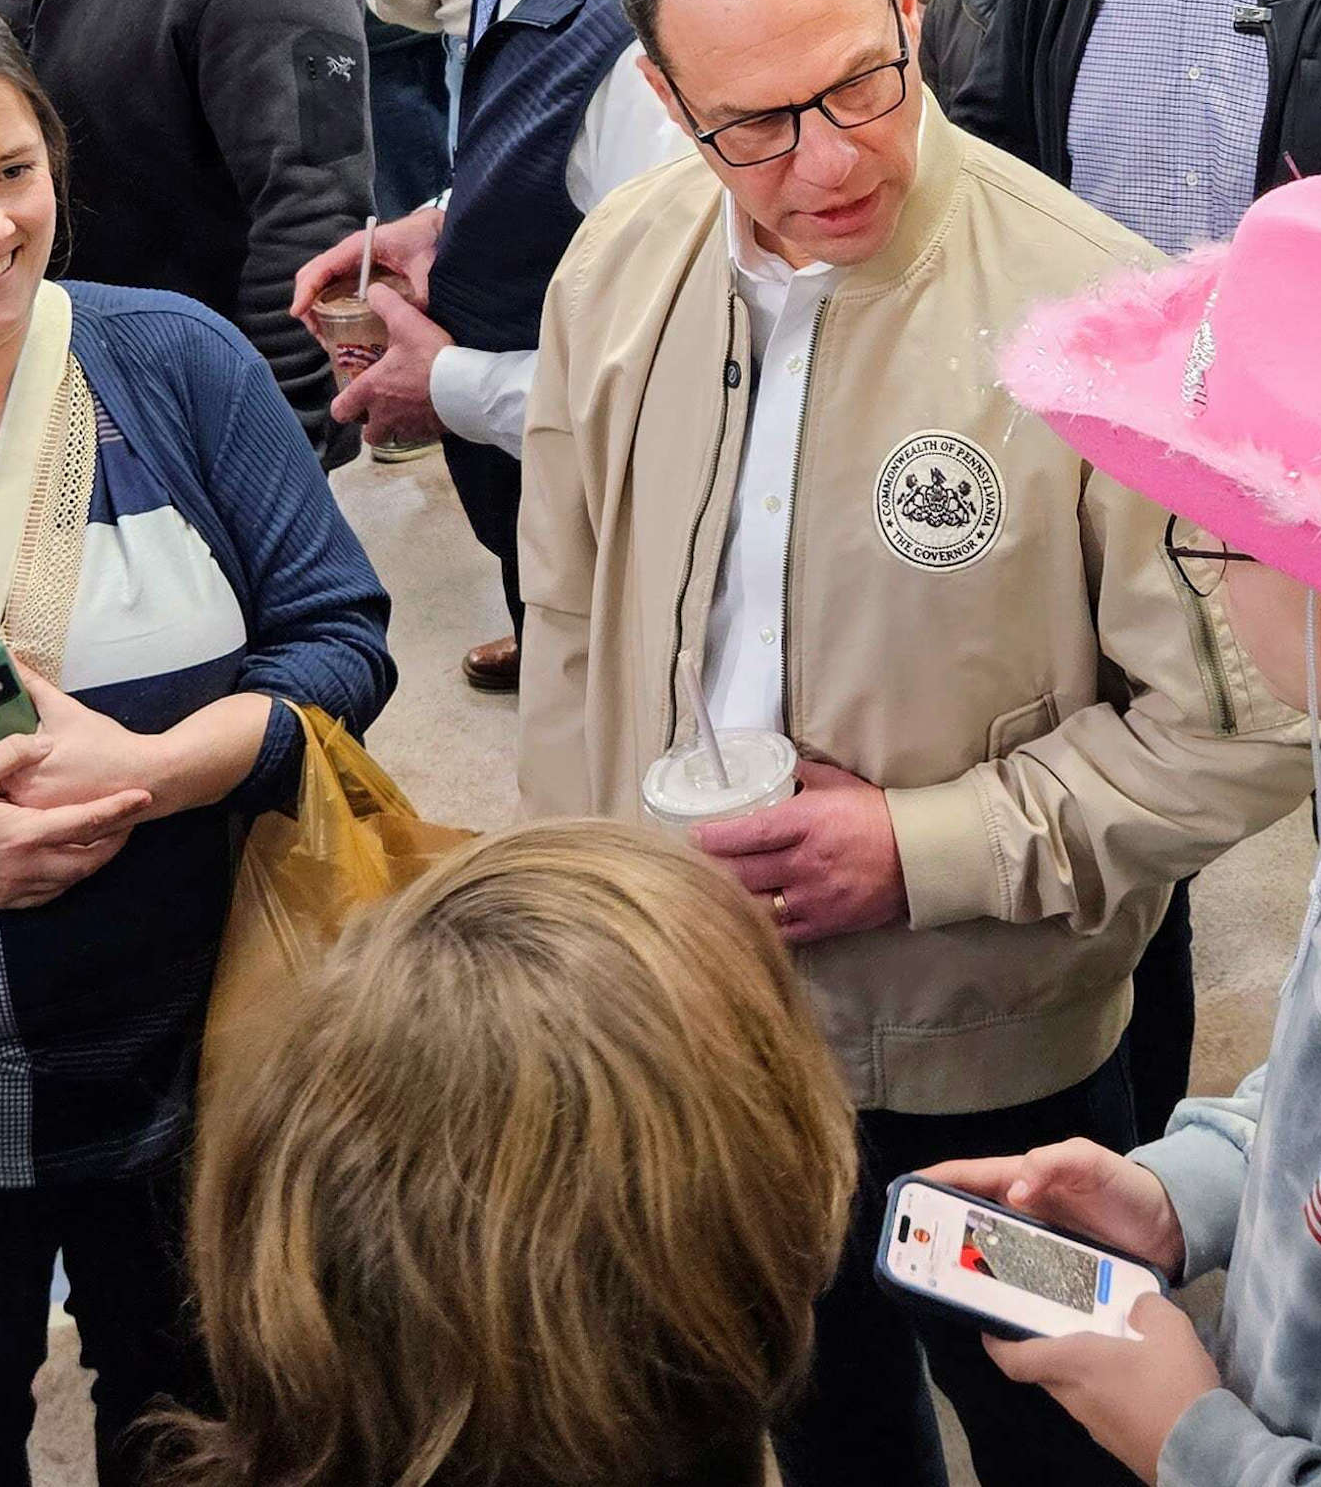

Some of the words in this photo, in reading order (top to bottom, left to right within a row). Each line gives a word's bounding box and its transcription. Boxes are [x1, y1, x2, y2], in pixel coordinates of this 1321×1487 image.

[881, 440, 937, 516] COMMONWEALTH
[940, 441, 957, 453] OF
[956, 447, 996, 527] PENNSYLVANIA
[893, 530, 912, 553] THE
[914, 539, 978, 561] GOVERNOR
